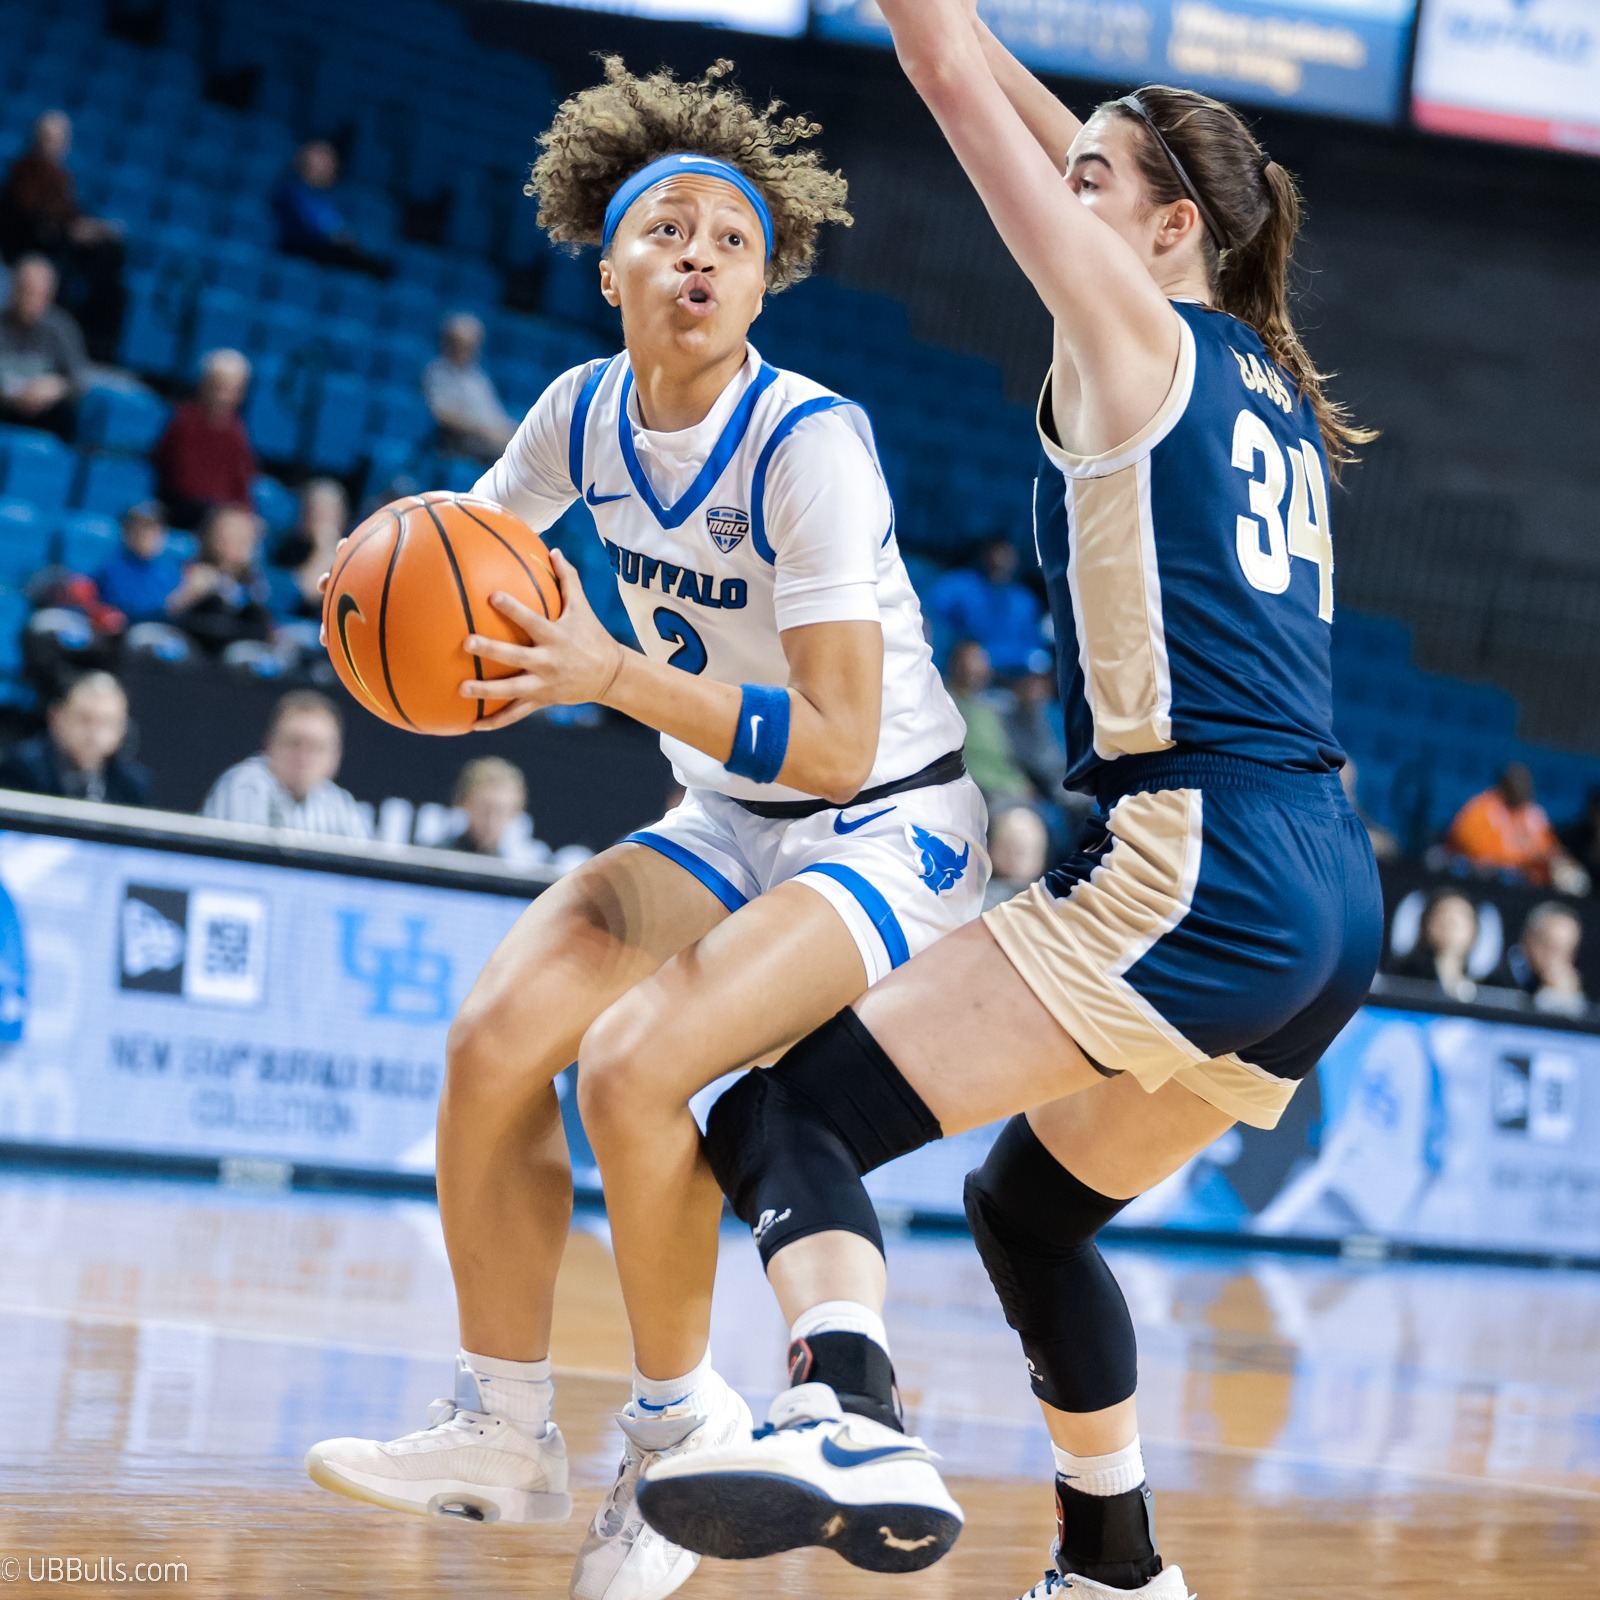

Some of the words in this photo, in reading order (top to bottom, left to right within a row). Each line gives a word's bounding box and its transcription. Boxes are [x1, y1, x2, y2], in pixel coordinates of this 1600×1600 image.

[1228, 345, 1293, 413] BASS
[709, 519, 748, 536] MAC
[1231, 408, 1334, 625] 34
[652, 606, 708, 676] 2
